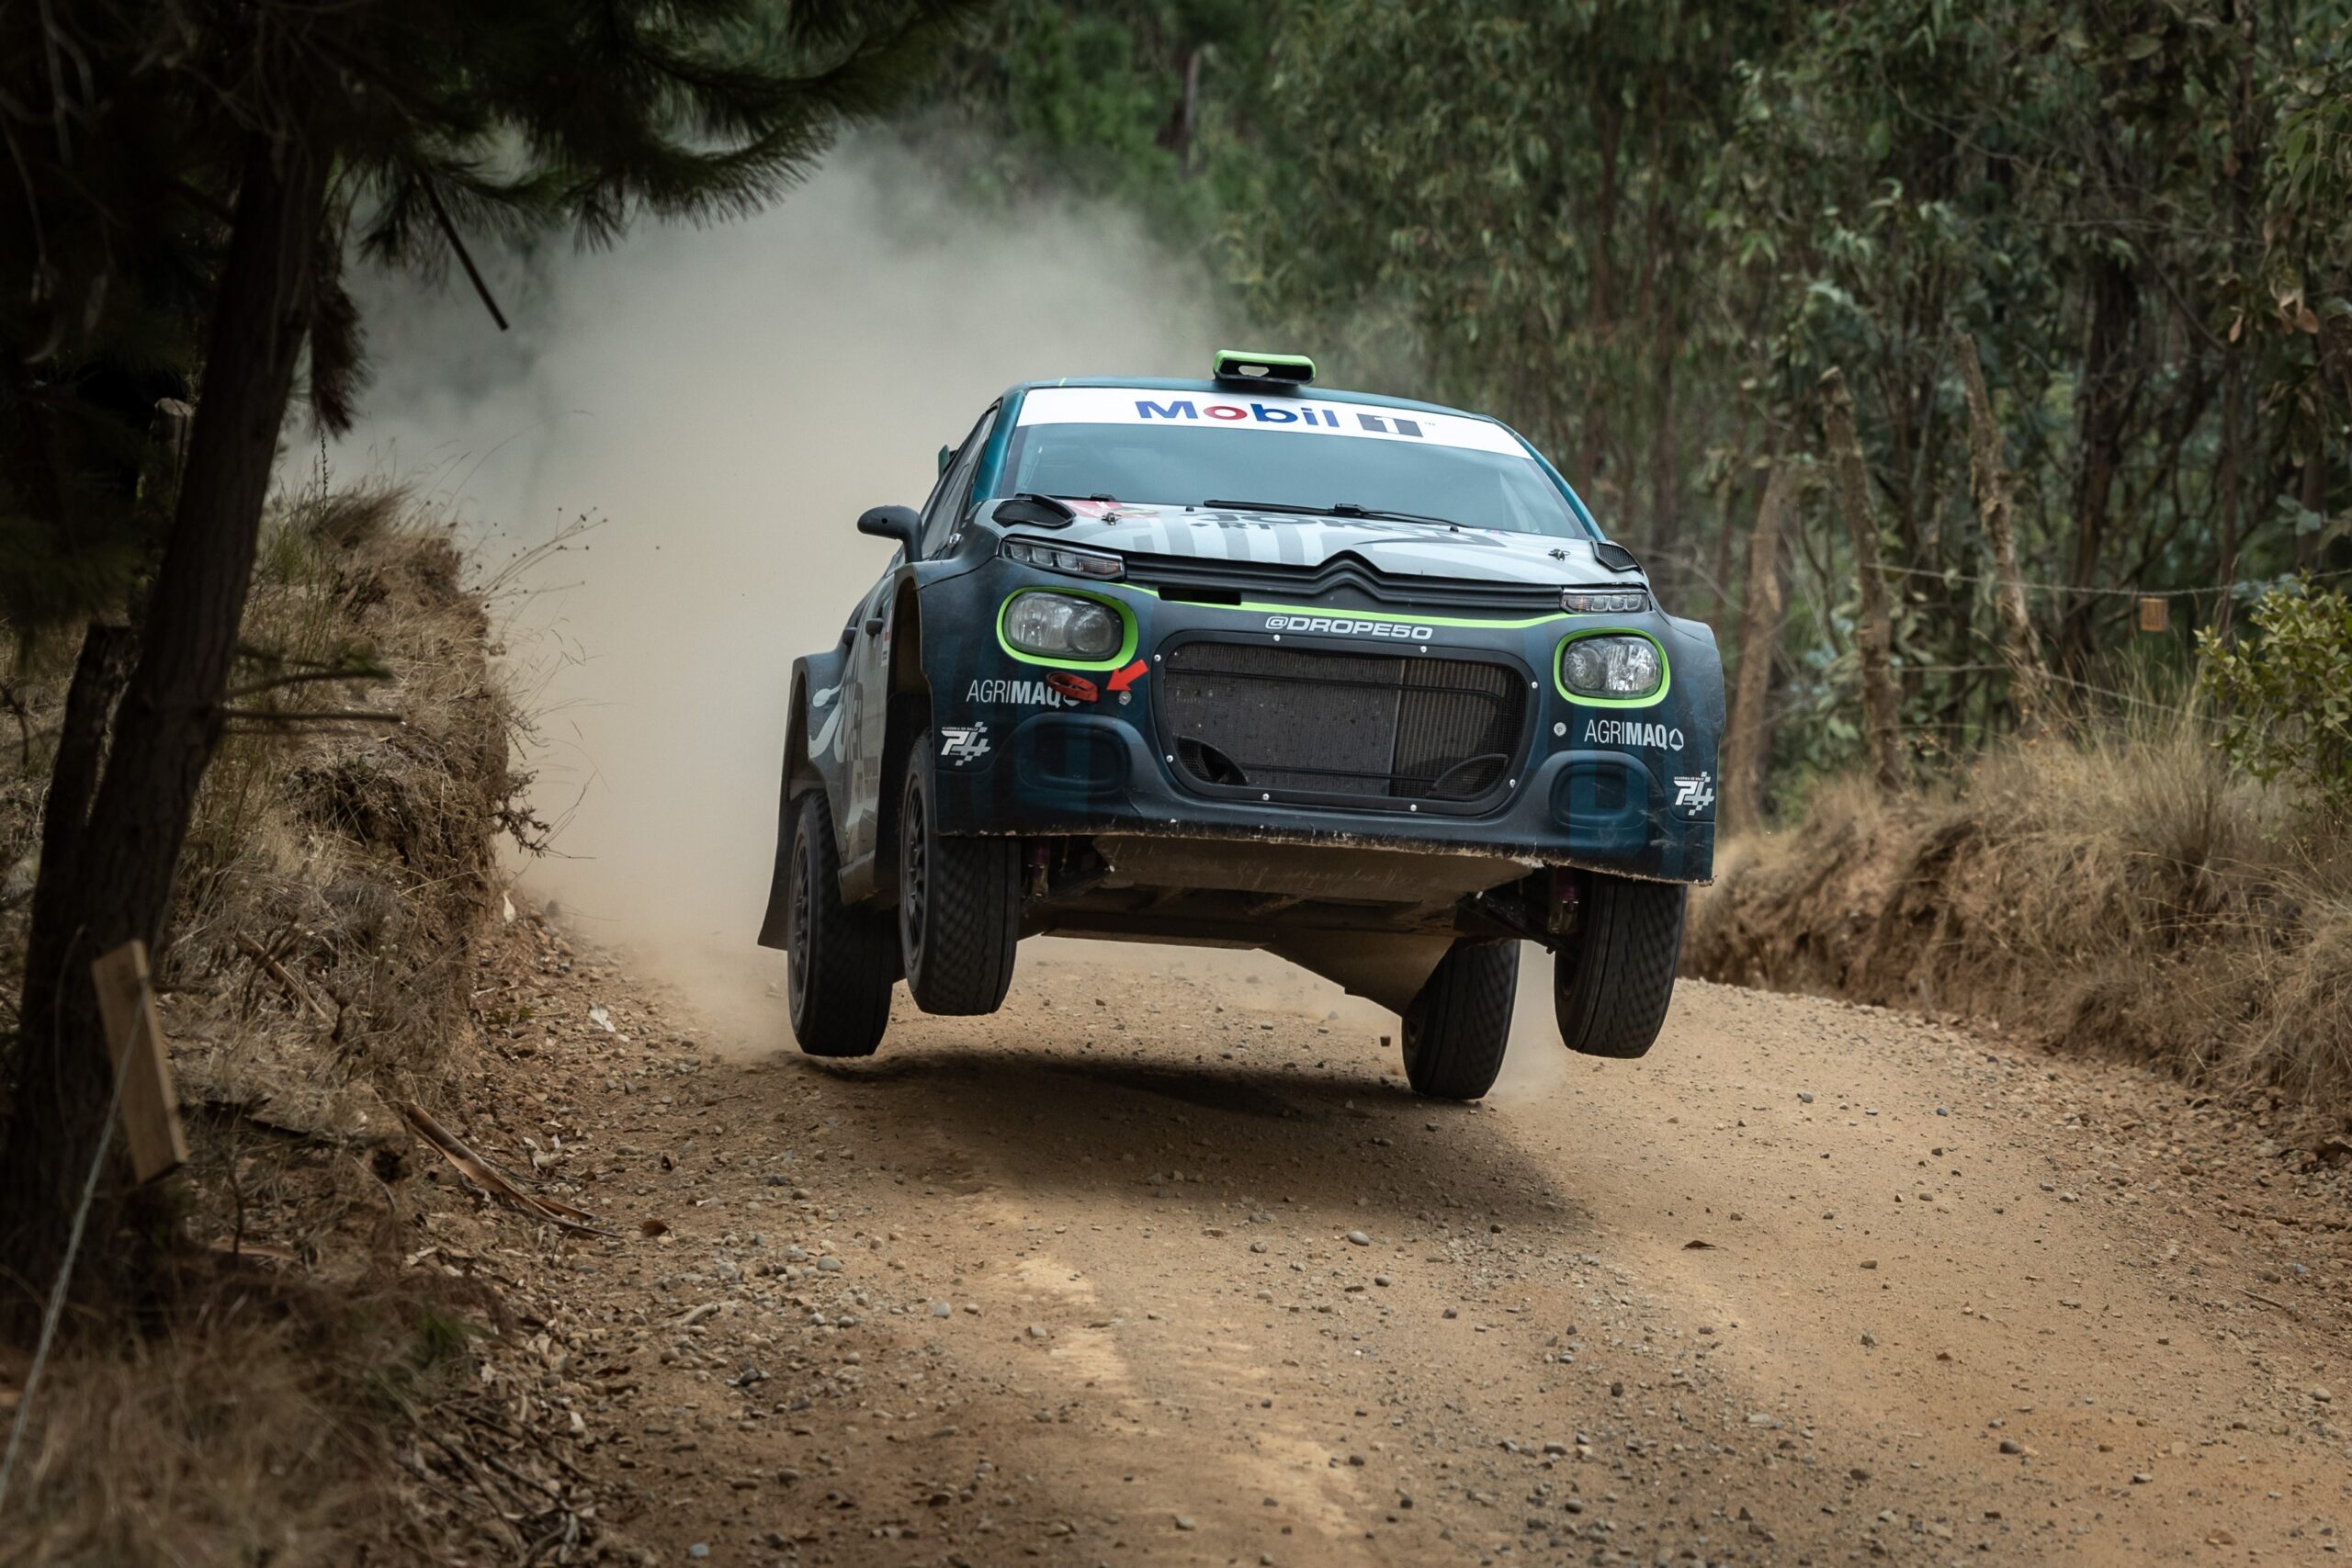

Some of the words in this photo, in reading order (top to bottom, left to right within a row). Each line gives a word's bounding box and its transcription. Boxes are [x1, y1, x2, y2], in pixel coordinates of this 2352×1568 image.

[1135, 400, 1340, 428] Mobil
[966, 679, 1061, 708] AGRIMAQ
[1584, 719, 1668, 750] AGRIMAQ
